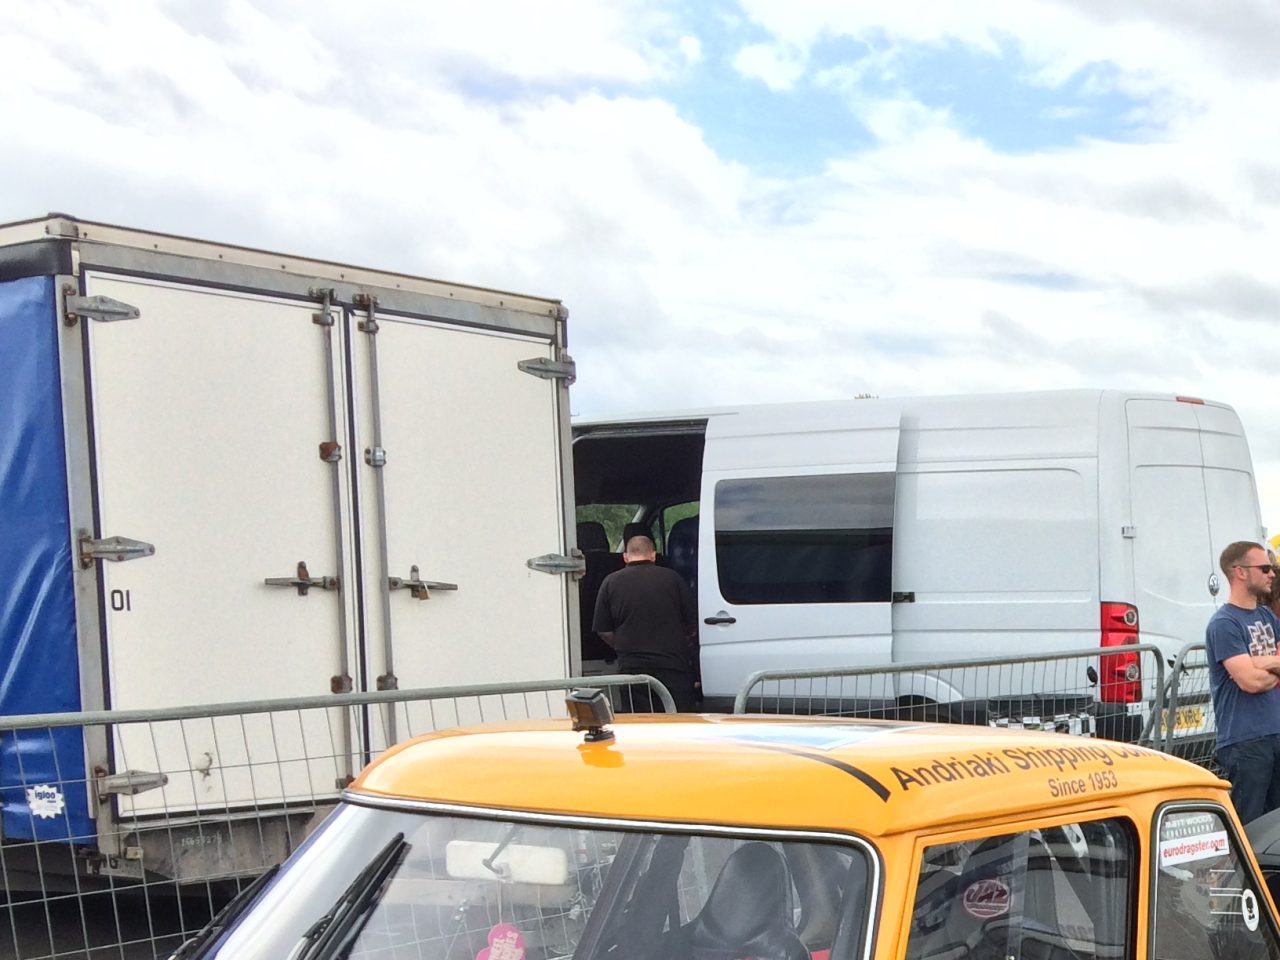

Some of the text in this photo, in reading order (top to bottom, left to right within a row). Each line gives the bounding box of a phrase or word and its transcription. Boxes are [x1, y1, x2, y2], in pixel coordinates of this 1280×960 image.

[890, 752, 1010, 791] Andriaki
[1003, 745, 1114, 772] Shipping
[34, 790, 56, 800] igloo
[1048, 770, 1119, 798] Since 1953
[1163, 838, 1226, 858] eurodragster.com
